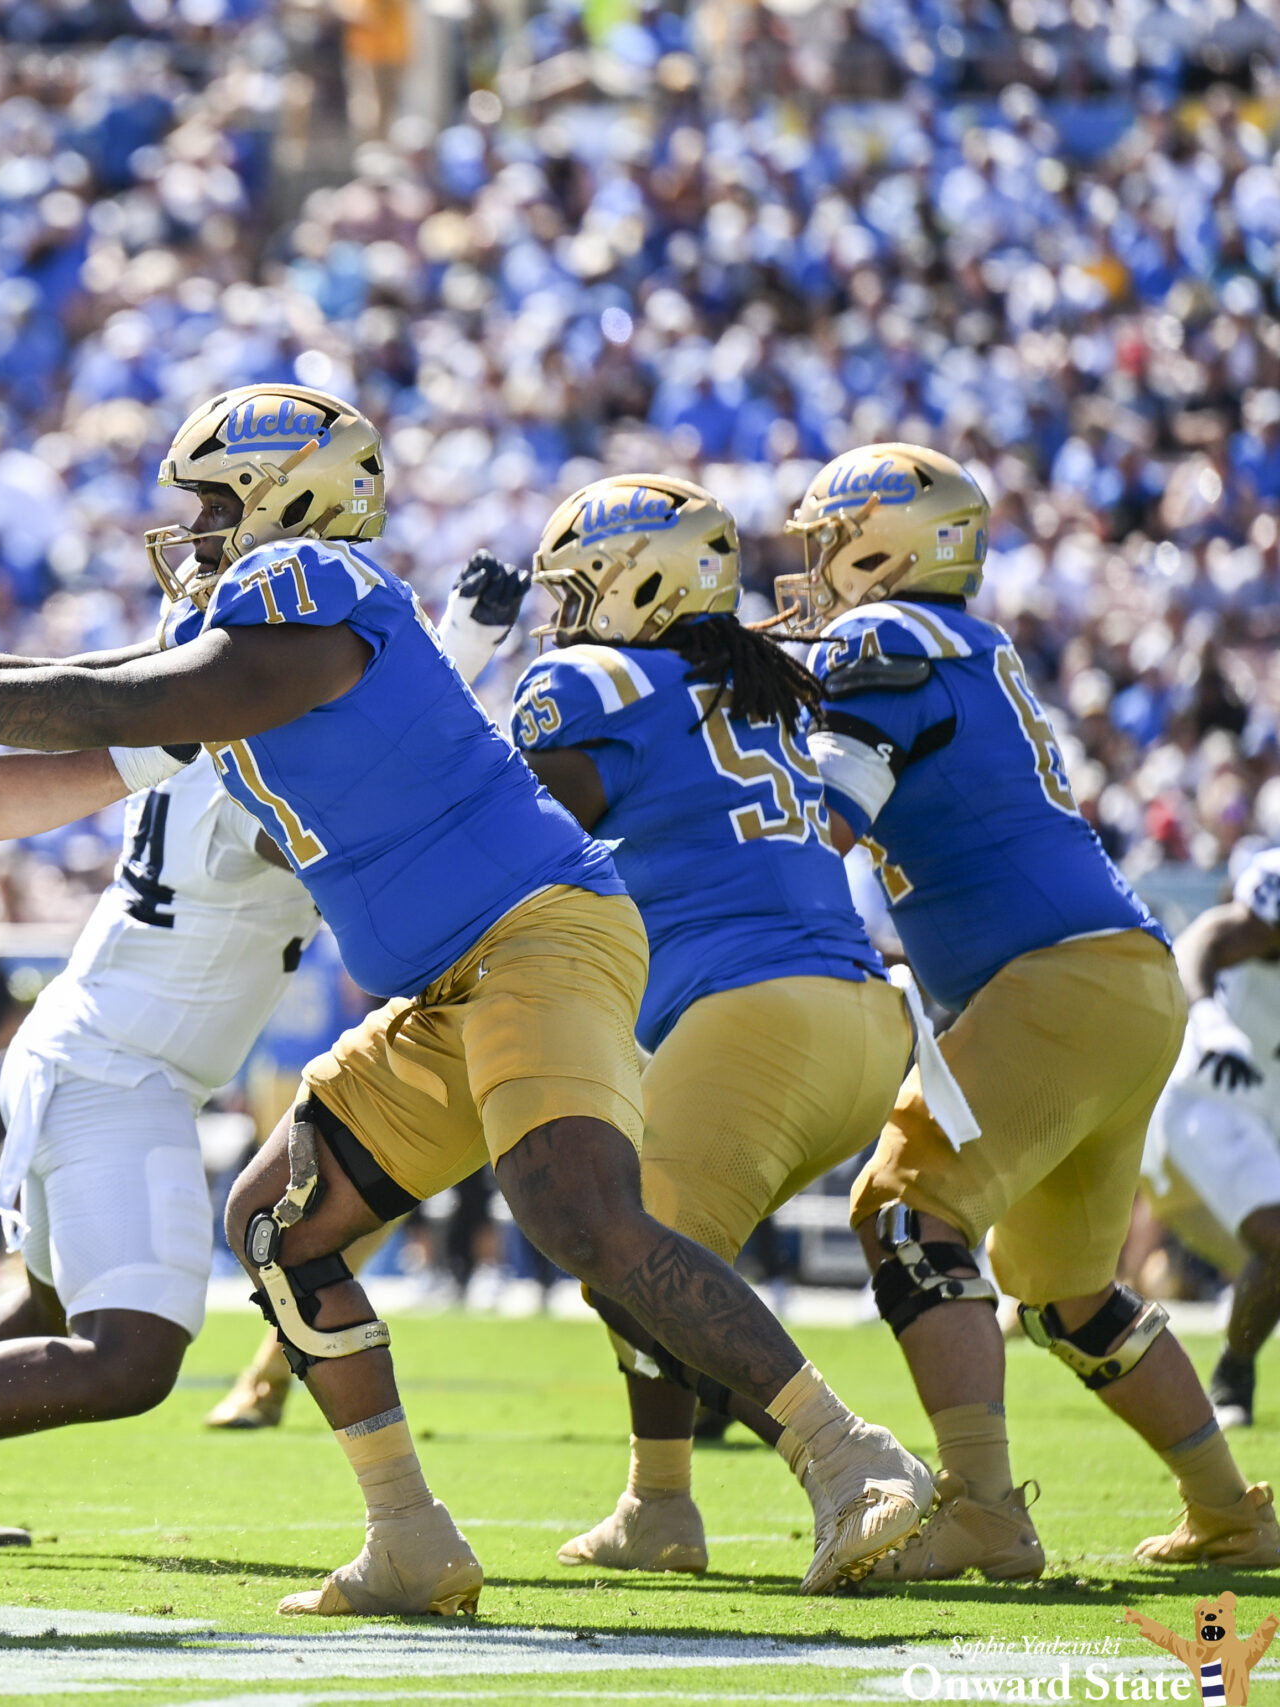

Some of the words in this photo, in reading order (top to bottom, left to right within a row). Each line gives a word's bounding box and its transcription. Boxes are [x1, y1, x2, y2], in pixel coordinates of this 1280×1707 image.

[226, 400, 331, 455] Ucla
[240, 554, 318, 624] 77
[515, 672, 562, 746] 55
[201, 737, 329, 871] 7
